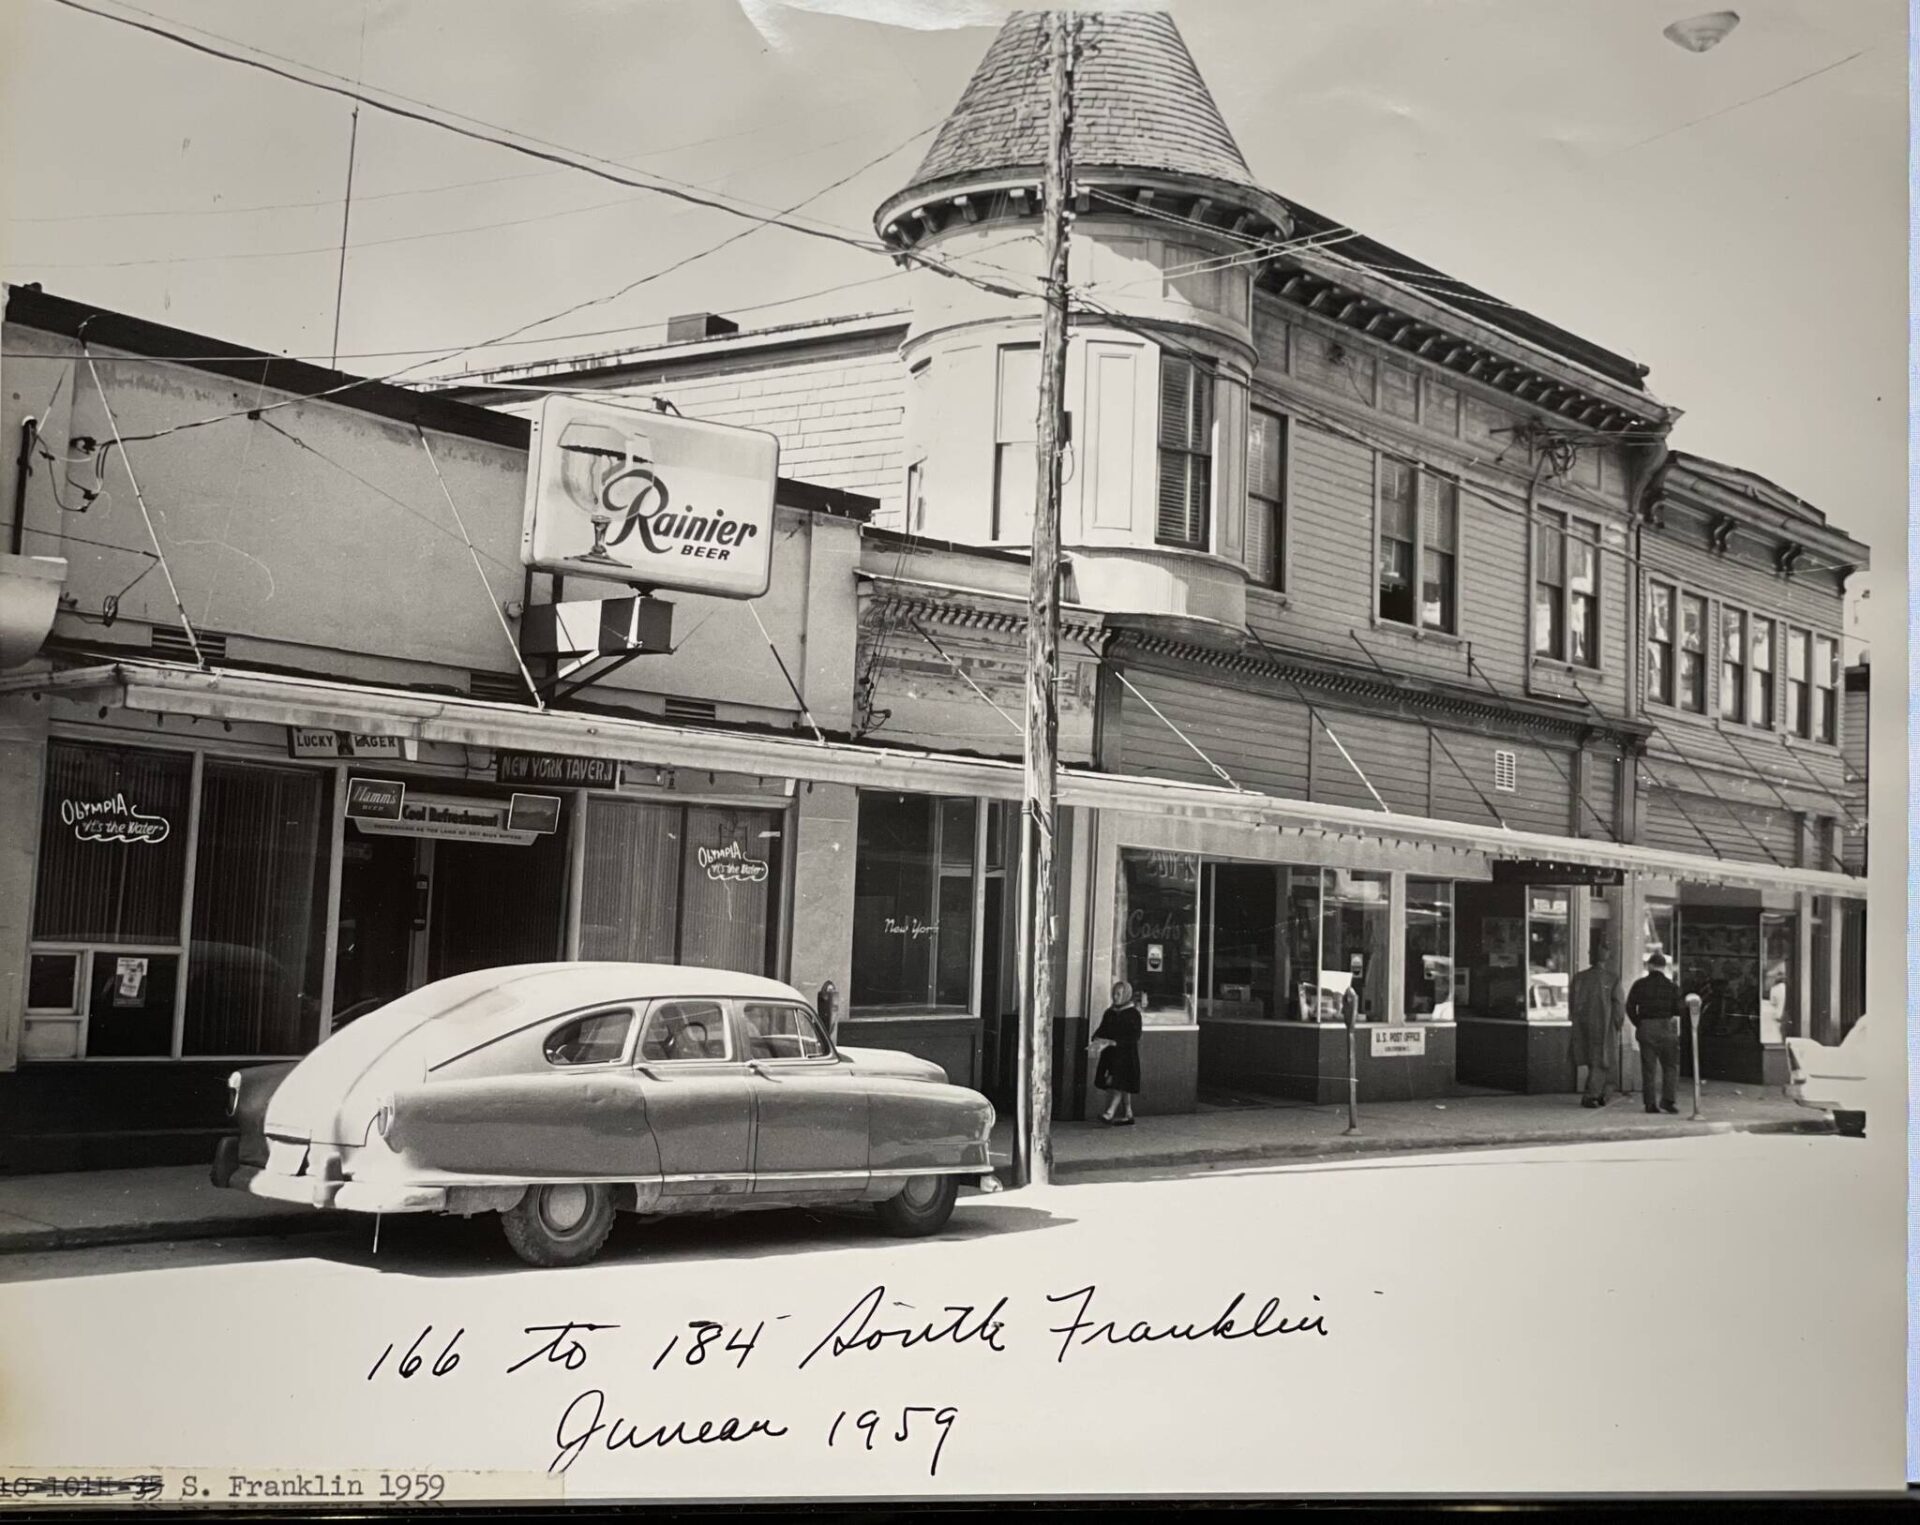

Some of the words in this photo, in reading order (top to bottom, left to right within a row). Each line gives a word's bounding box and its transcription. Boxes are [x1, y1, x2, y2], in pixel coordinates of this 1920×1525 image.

[602, 468, 758, 554] Rainier
[680, 544, 731, 561] BEER
[297, 735, 335, 748] LUCKY
[354, 735, 397, 748] LAGER
[501, 756, 530, 779] NEW
[532, 757, 563, 779] YORK
[352, 786, 398, 805] Hamm's
[61, 793, 128, 825] OLYMPIA
[402, 804, 427, 821] Cool
[105, 821, 126, 834] the
[698, 841, 742, 868] OLYMPIA
[884, 917, 909, 934] New
[367, 1325, 465, 1381] 166
[507, 1321, 620, 1374] to
[653, 1320, 765, 1370] 184
[799, 1285, 1009, 1370] South
[1047, 1285, 1328, 1363] Franklin
[828, 1406, 958, 1477] 1959
[181, 1475, 210, 1498] S.
[228, 1475, 365, 1498] Franklin
[379, 1474, 446, 1500] 1959
